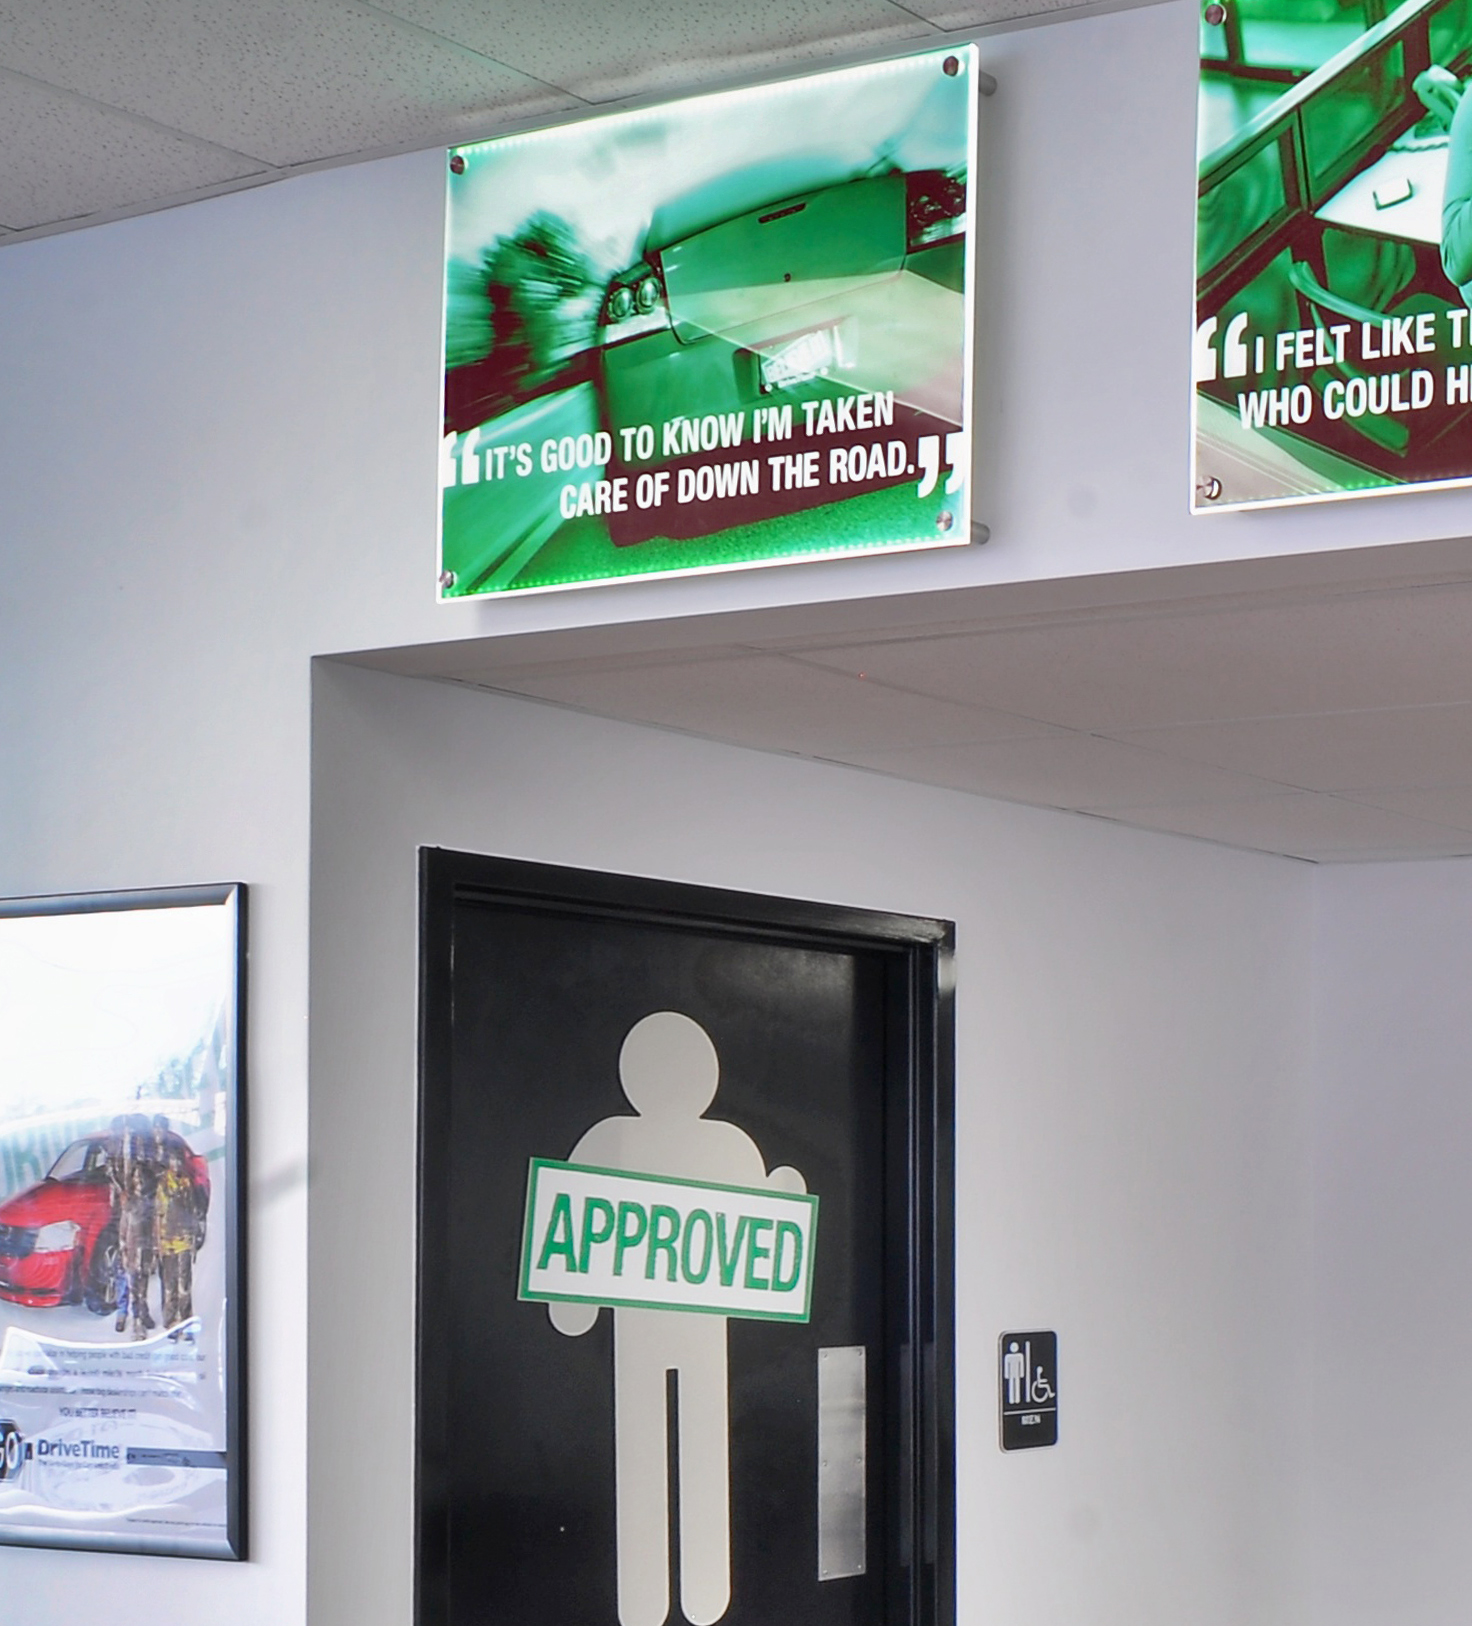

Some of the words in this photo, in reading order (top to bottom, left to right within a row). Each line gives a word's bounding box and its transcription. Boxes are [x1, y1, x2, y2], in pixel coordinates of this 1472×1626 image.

[1254, 337, 1264, 374] I
[1276, 325, 1351, 371] FELT
[1361, 314, 1436, 360] LIKE
[1238, 383, 1313, 430] WHO
[1324, 370, 1433, 420] COULD
[486, 444, 532, 482] IT'S
[541, 431, 612, 475] GOOD
[621, 424, 654, 461] TO
[663, 411, 745, 456] KNOW
[753, 404, 792, 444] I'M
[802, 391, 895, 436] TAKEN
[560, 480, 628, 519] CARE
[636, 473, 670, 508] OF
[678, 460, 759, 503] DOWN
[768, 452, 820, 491] THE
[830, 444, 915, 483] ROAD.
[536, 1193, 804, 1294] APPROVED
[37, 1438, 120, 1460] DriveTime
